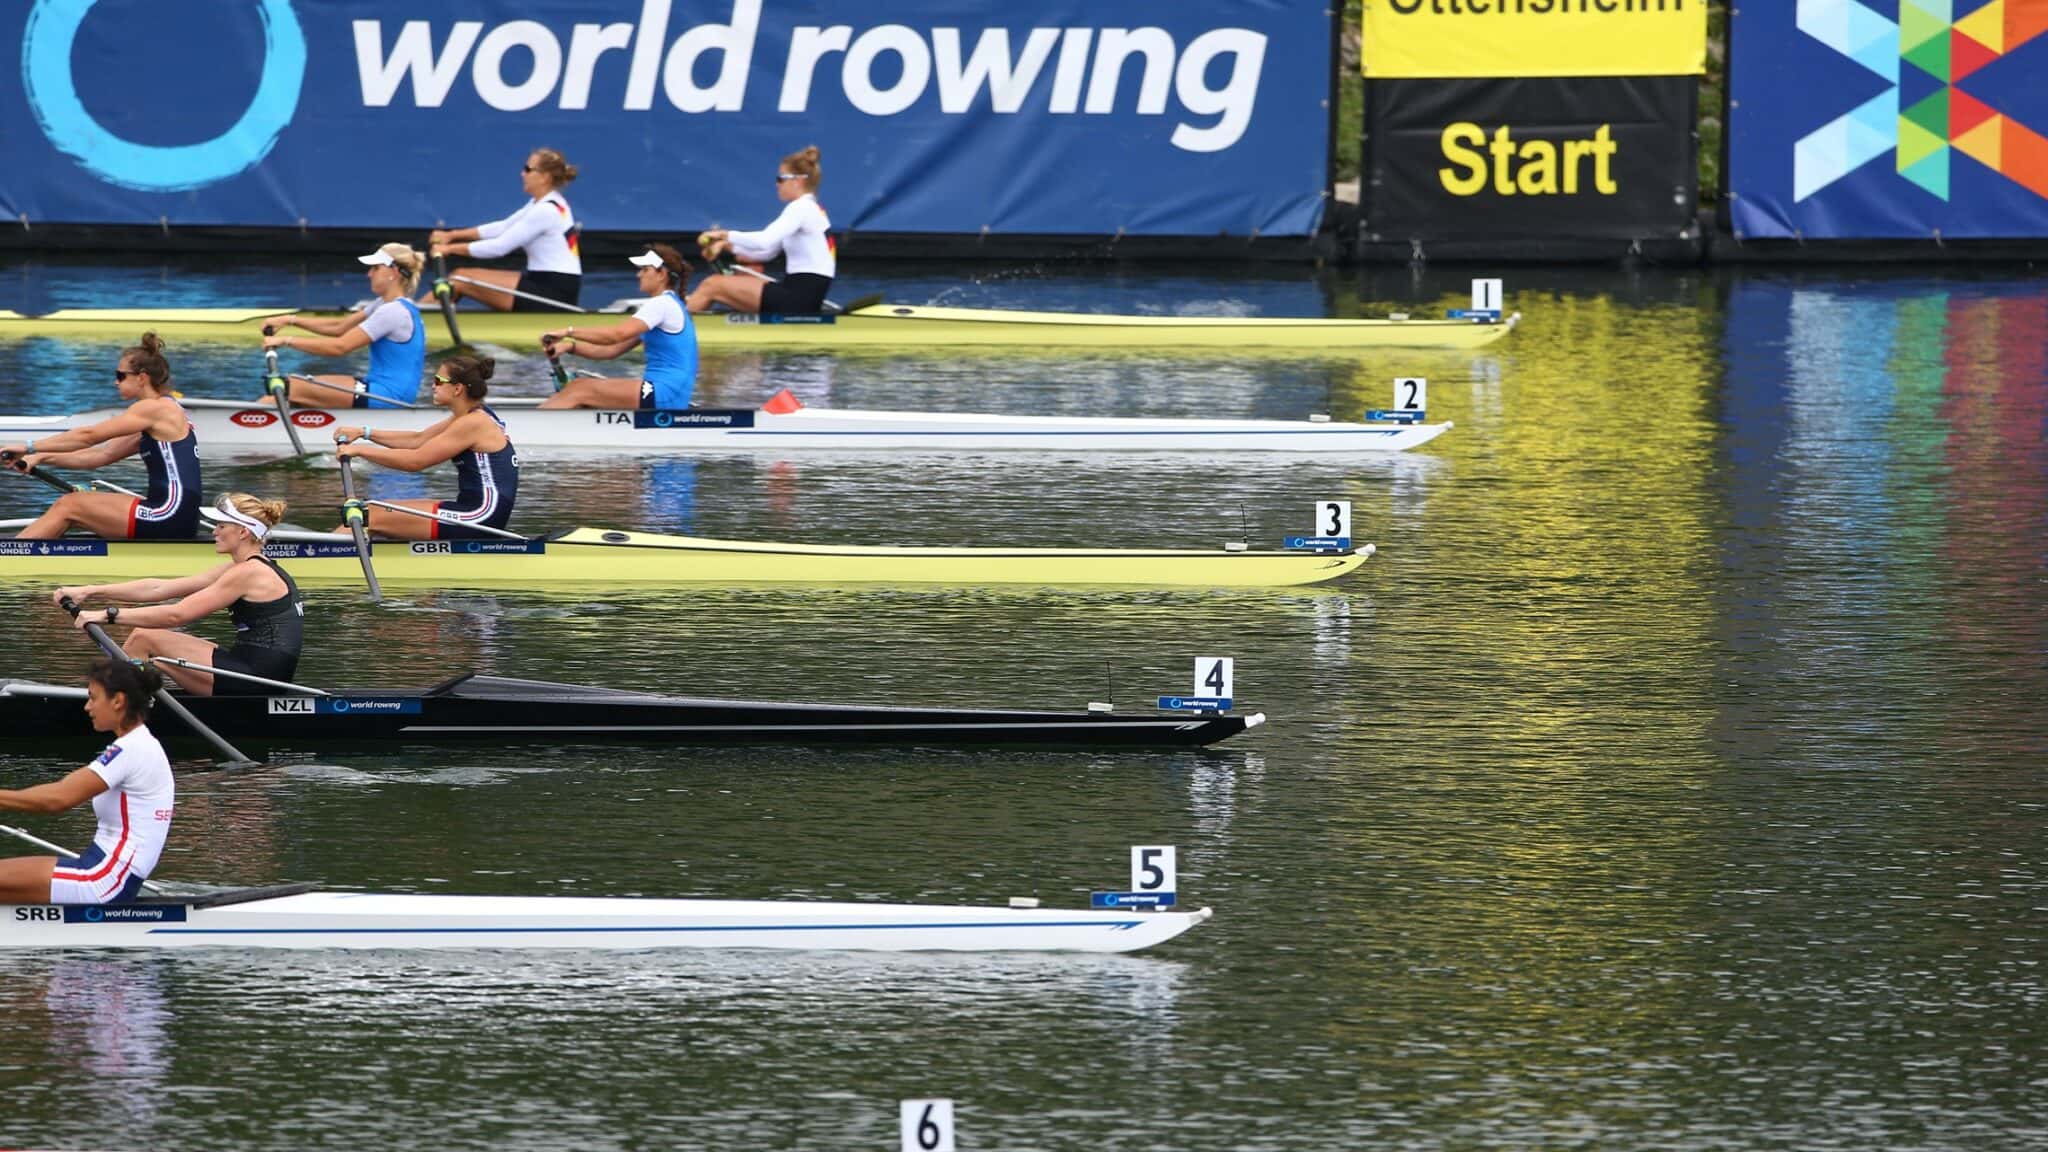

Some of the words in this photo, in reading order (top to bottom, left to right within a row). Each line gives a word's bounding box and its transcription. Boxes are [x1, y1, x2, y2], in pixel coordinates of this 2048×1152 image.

[352, 0, 763, 113] world
[778, 24, 1268, 152] rowing
[1439, 122, 1617, 195] Start
[1484, 282, 1489, 308] 1
[1404, 380, 1418, 409] 2
[241, 414, 268, 425] coop
[298, 414, 326, 425] coop
[596, 412, 631, 424] ITA
[1326, 503, 1341, 536] 3
[67, 545, 92, 553] sport
[412, 543, 449, 553] GBR
[1205, 659, 1224, 696] 4
[274, 701, 312, 712] NZL
[1140, 849, 1164, 889] 5
[16, 907, 61, 921] SRB
[105, 908, 130, 917] world
[132, 909, 163, 919] rowing
[918, 1103, 939, 1150] 6
